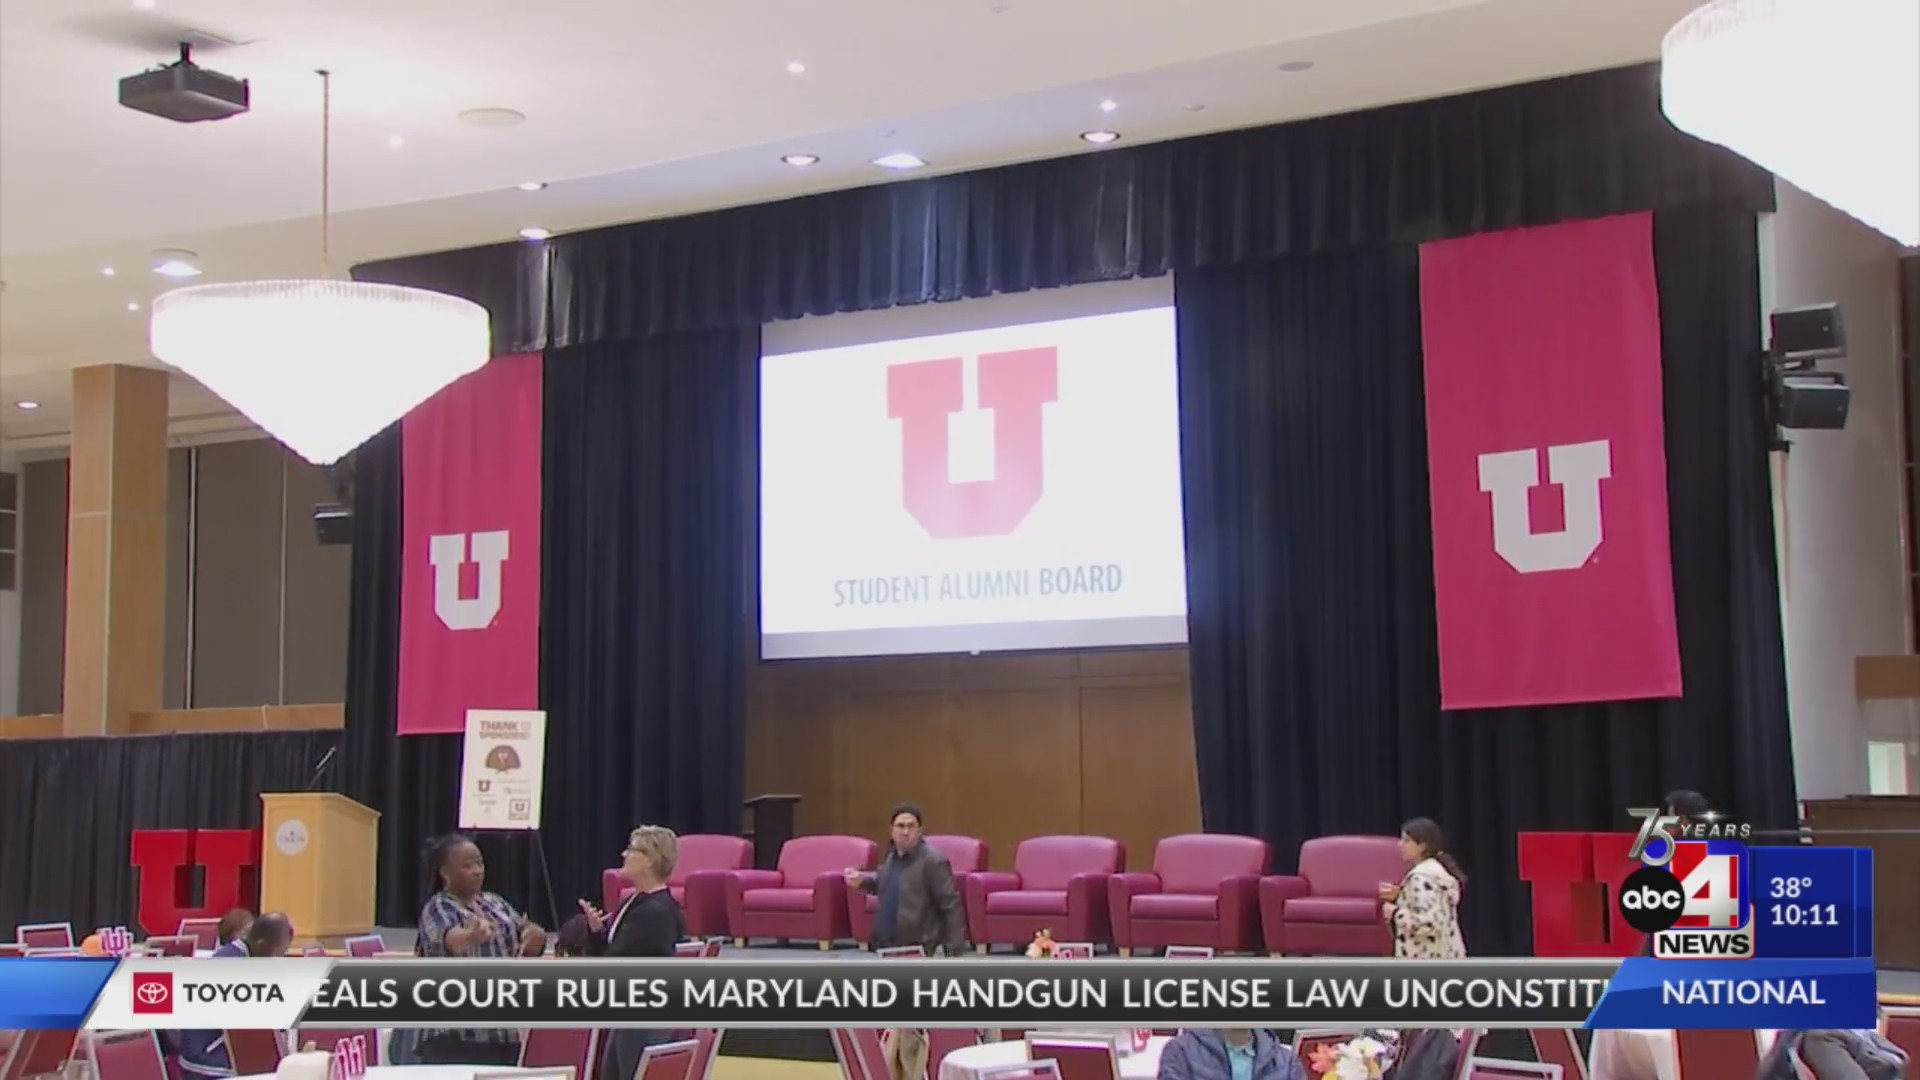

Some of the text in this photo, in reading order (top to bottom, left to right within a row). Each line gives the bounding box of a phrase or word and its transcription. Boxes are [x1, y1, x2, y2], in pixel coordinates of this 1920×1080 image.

[887, 346, 1058, 539] U
[1478, 439, 1612, 574] U
[429, 530, 509, 631] U
[833, 564, 1123, 607] STUDENT ALUMNI BOARD
